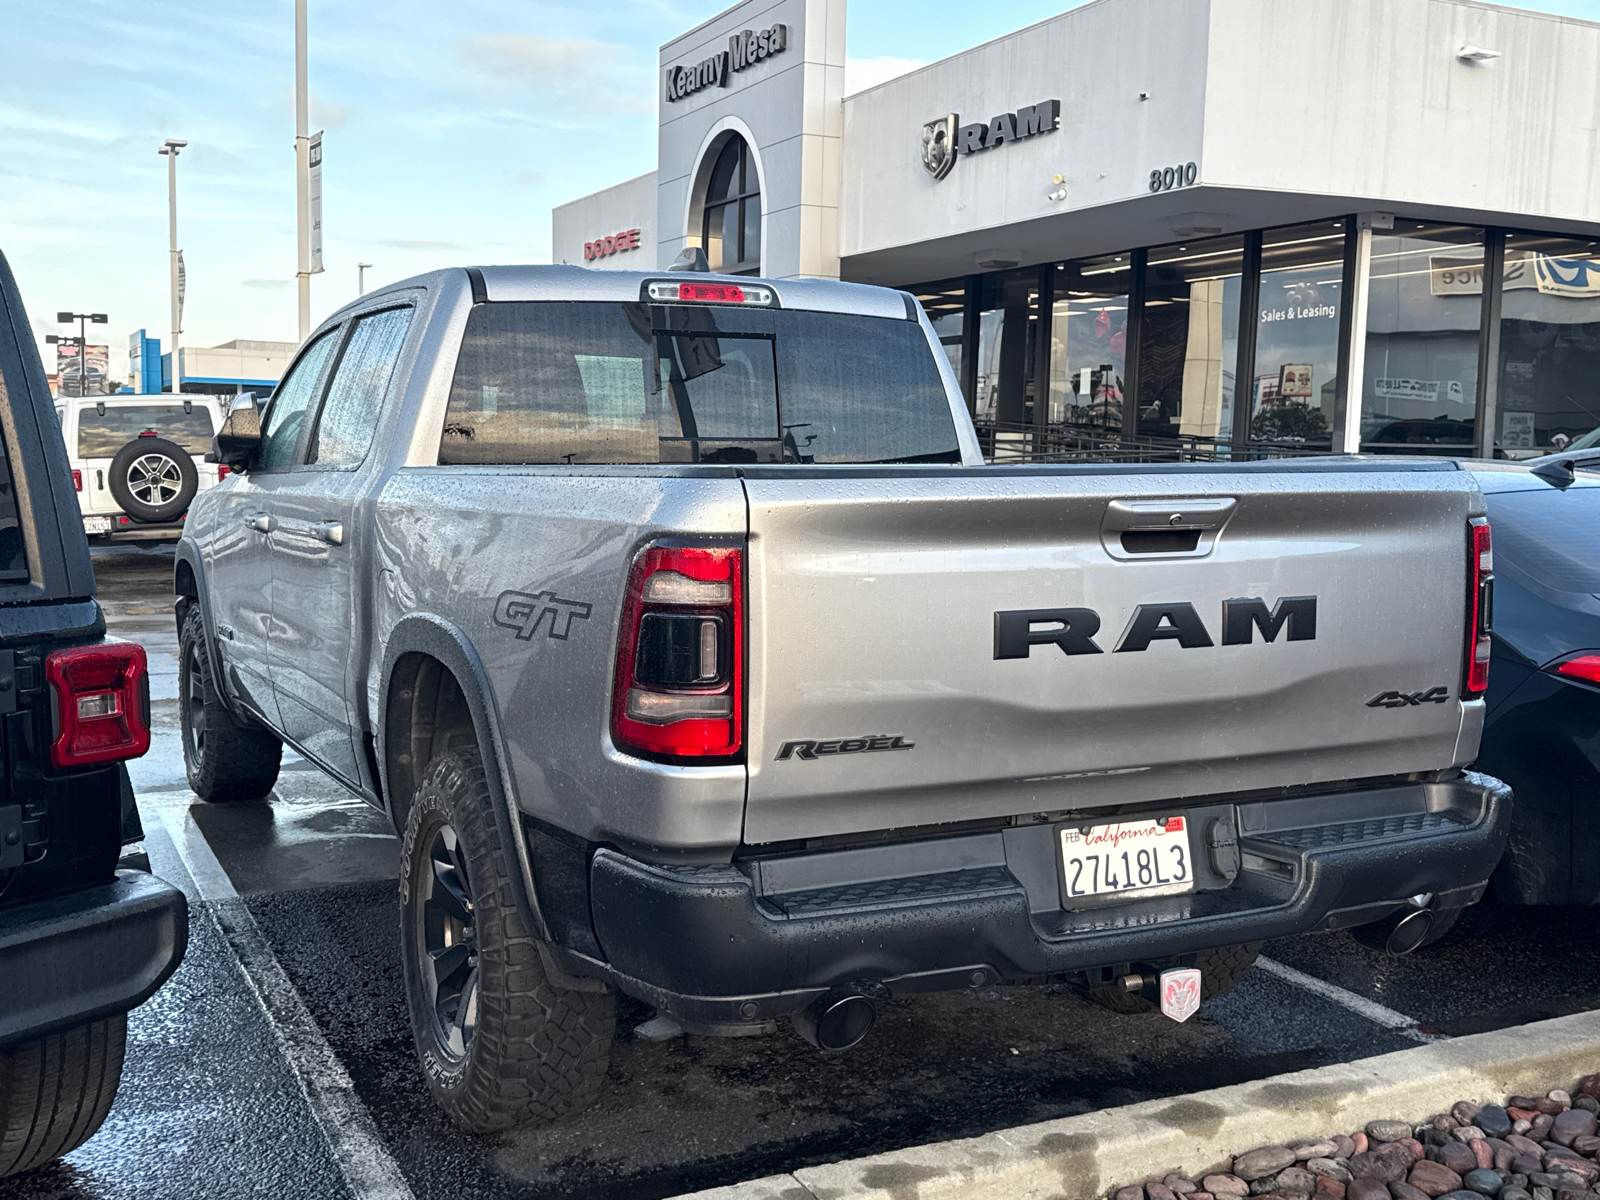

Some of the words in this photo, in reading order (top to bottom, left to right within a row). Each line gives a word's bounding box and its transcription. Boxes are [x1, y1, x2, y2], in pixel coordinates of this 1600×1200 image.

[665, 51, 729, 102] Kearny
[729, 23, 787, 72] Mesa
[957, 99, 1060, 156] RAM
[1149, 161, 1197, 192] 8010
[584, 228, 641, 261] DODGE
[1261, 308, 1286, 323] Sales
[1287, 307, 1295, 319] &
[1297, 303, 1336, 319] Leasing
[993, 595, 1317, 660] RAM
[1366, 686, 1450, 709] 4x4
[774, 734, 916, 762] REBEL
[1065, 831, 1080, 844] FEB
[1085, 823, 1166, 848] California
[1069, 844, 1187, 896] 27418L3
